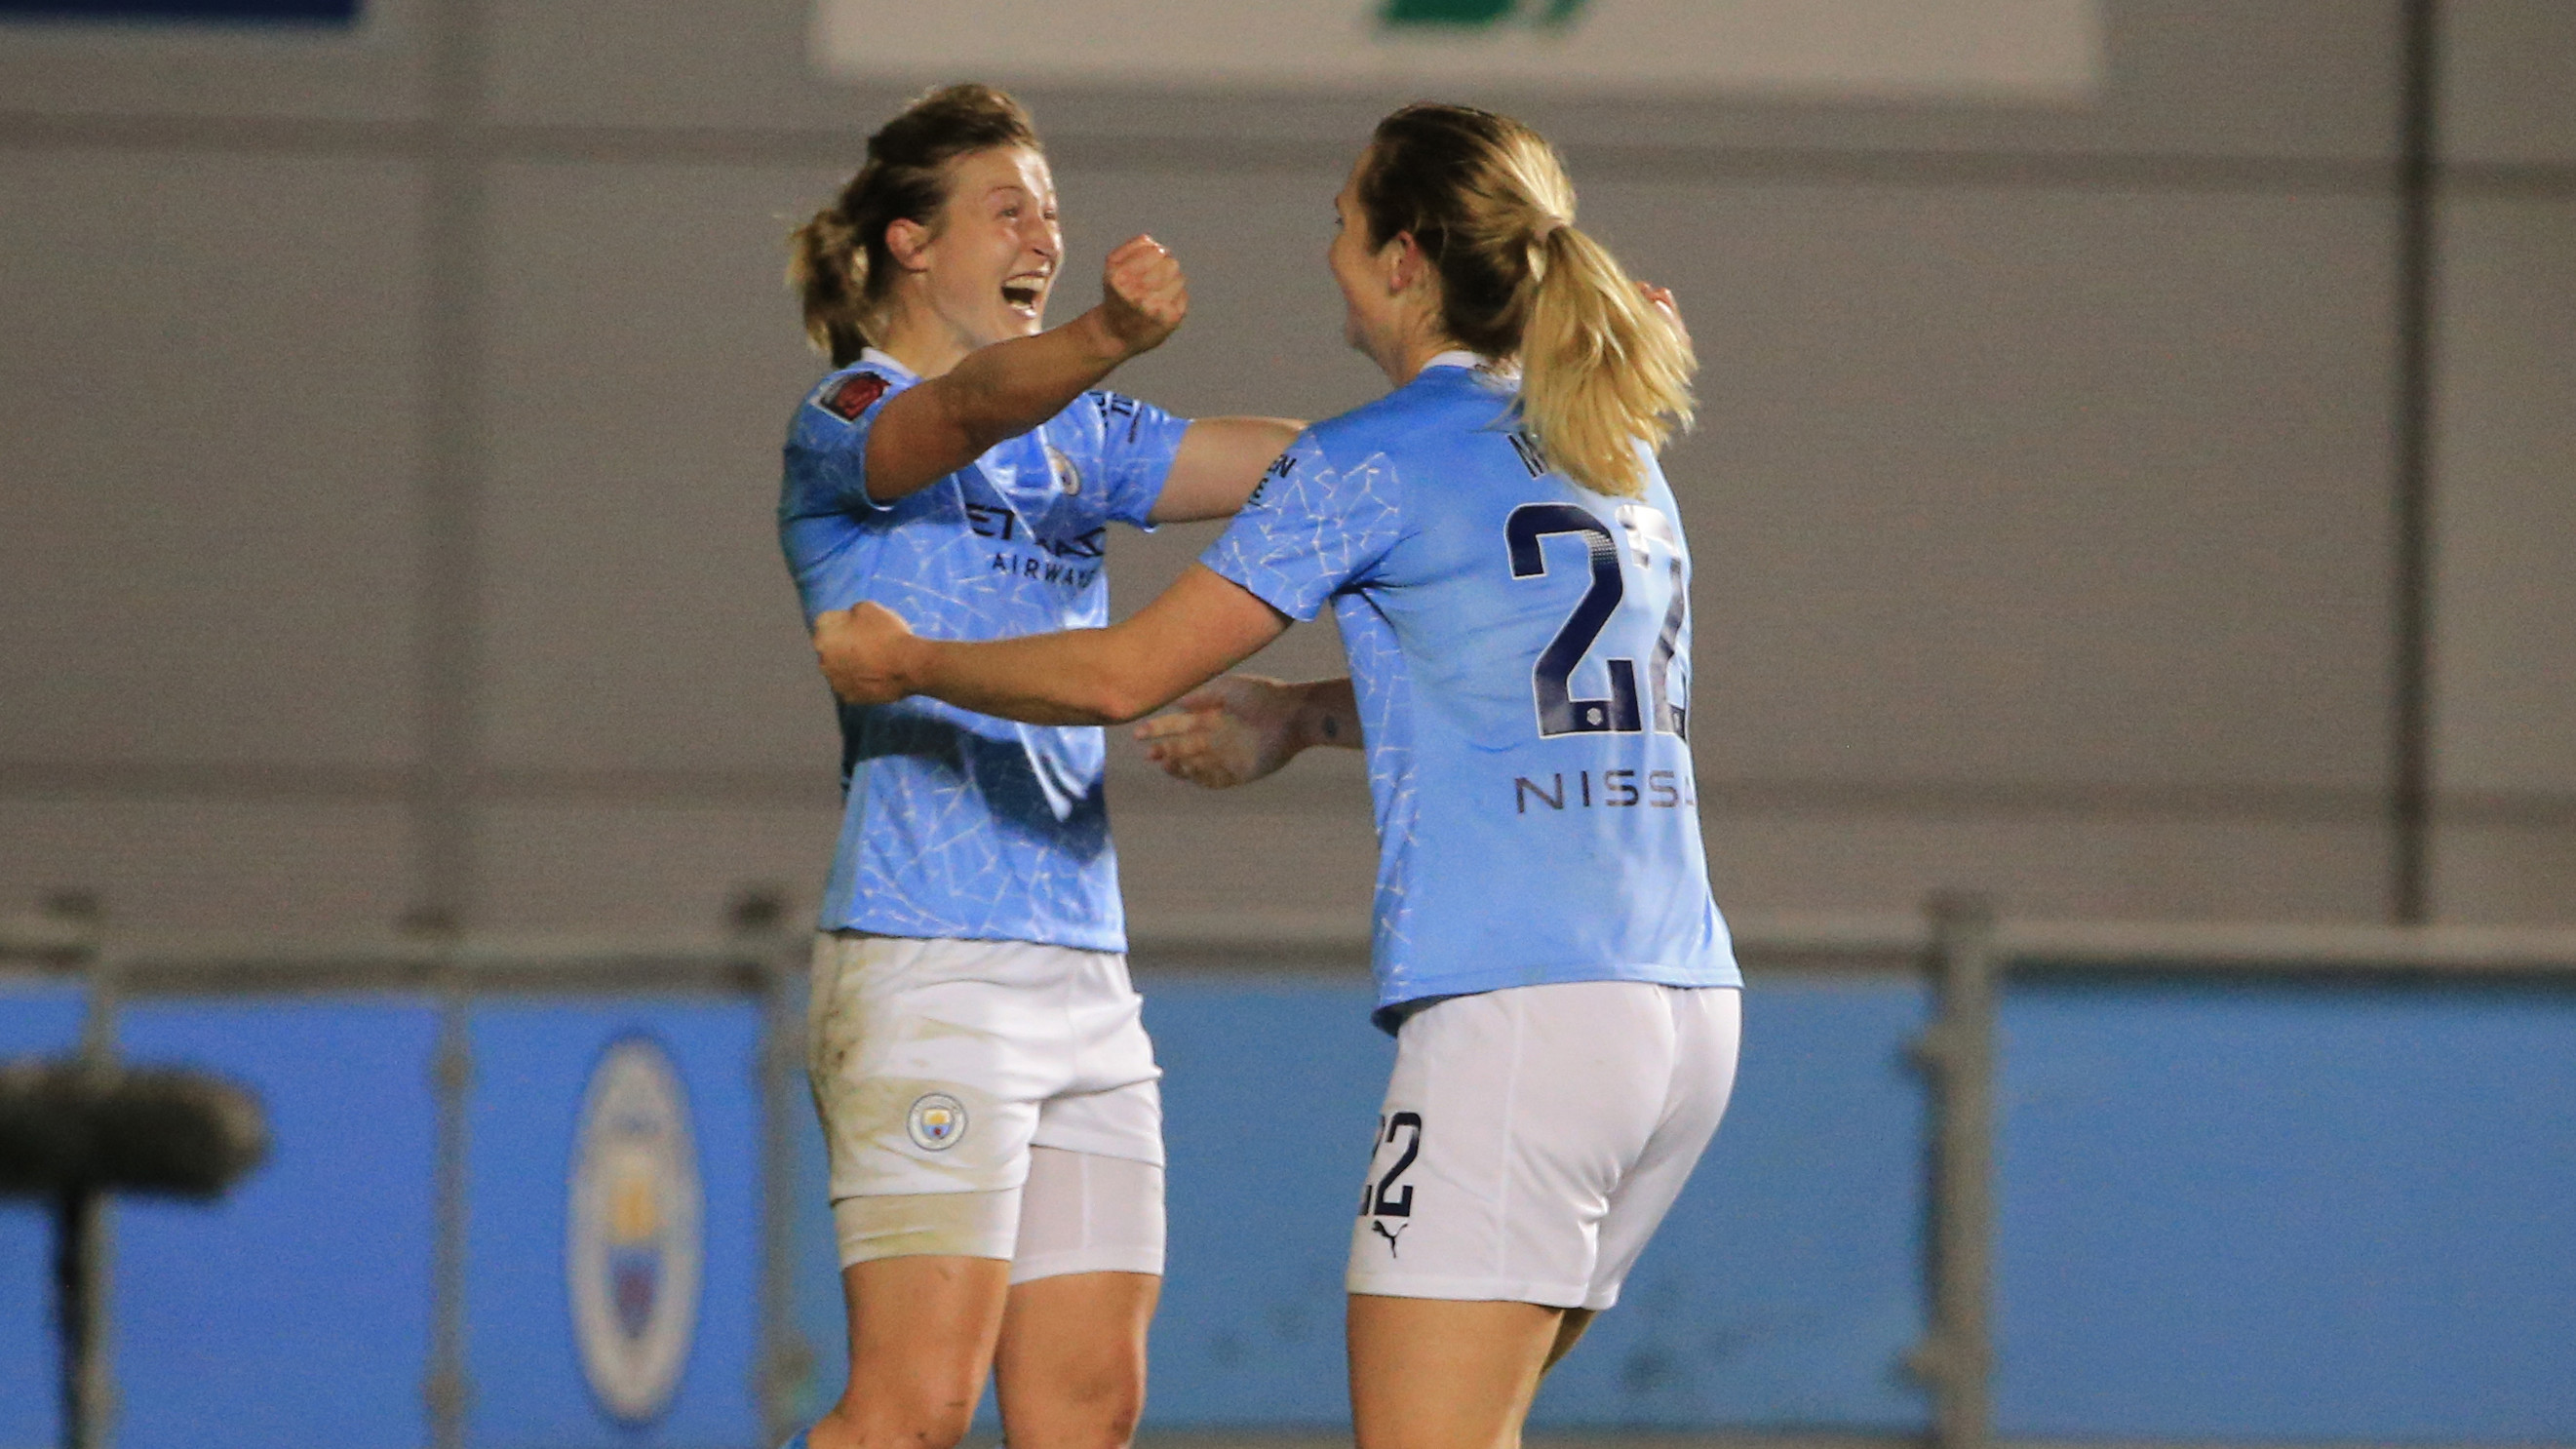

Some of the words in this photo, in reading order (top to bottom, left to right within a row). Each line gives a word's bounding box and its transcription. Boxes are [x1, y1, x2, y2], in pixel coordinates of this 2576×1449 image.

[992, 552, 1096, 589] AIRWAY
[1503, 502, 1690, 740] 22
[1514, 769, 1698, 814] NISS
